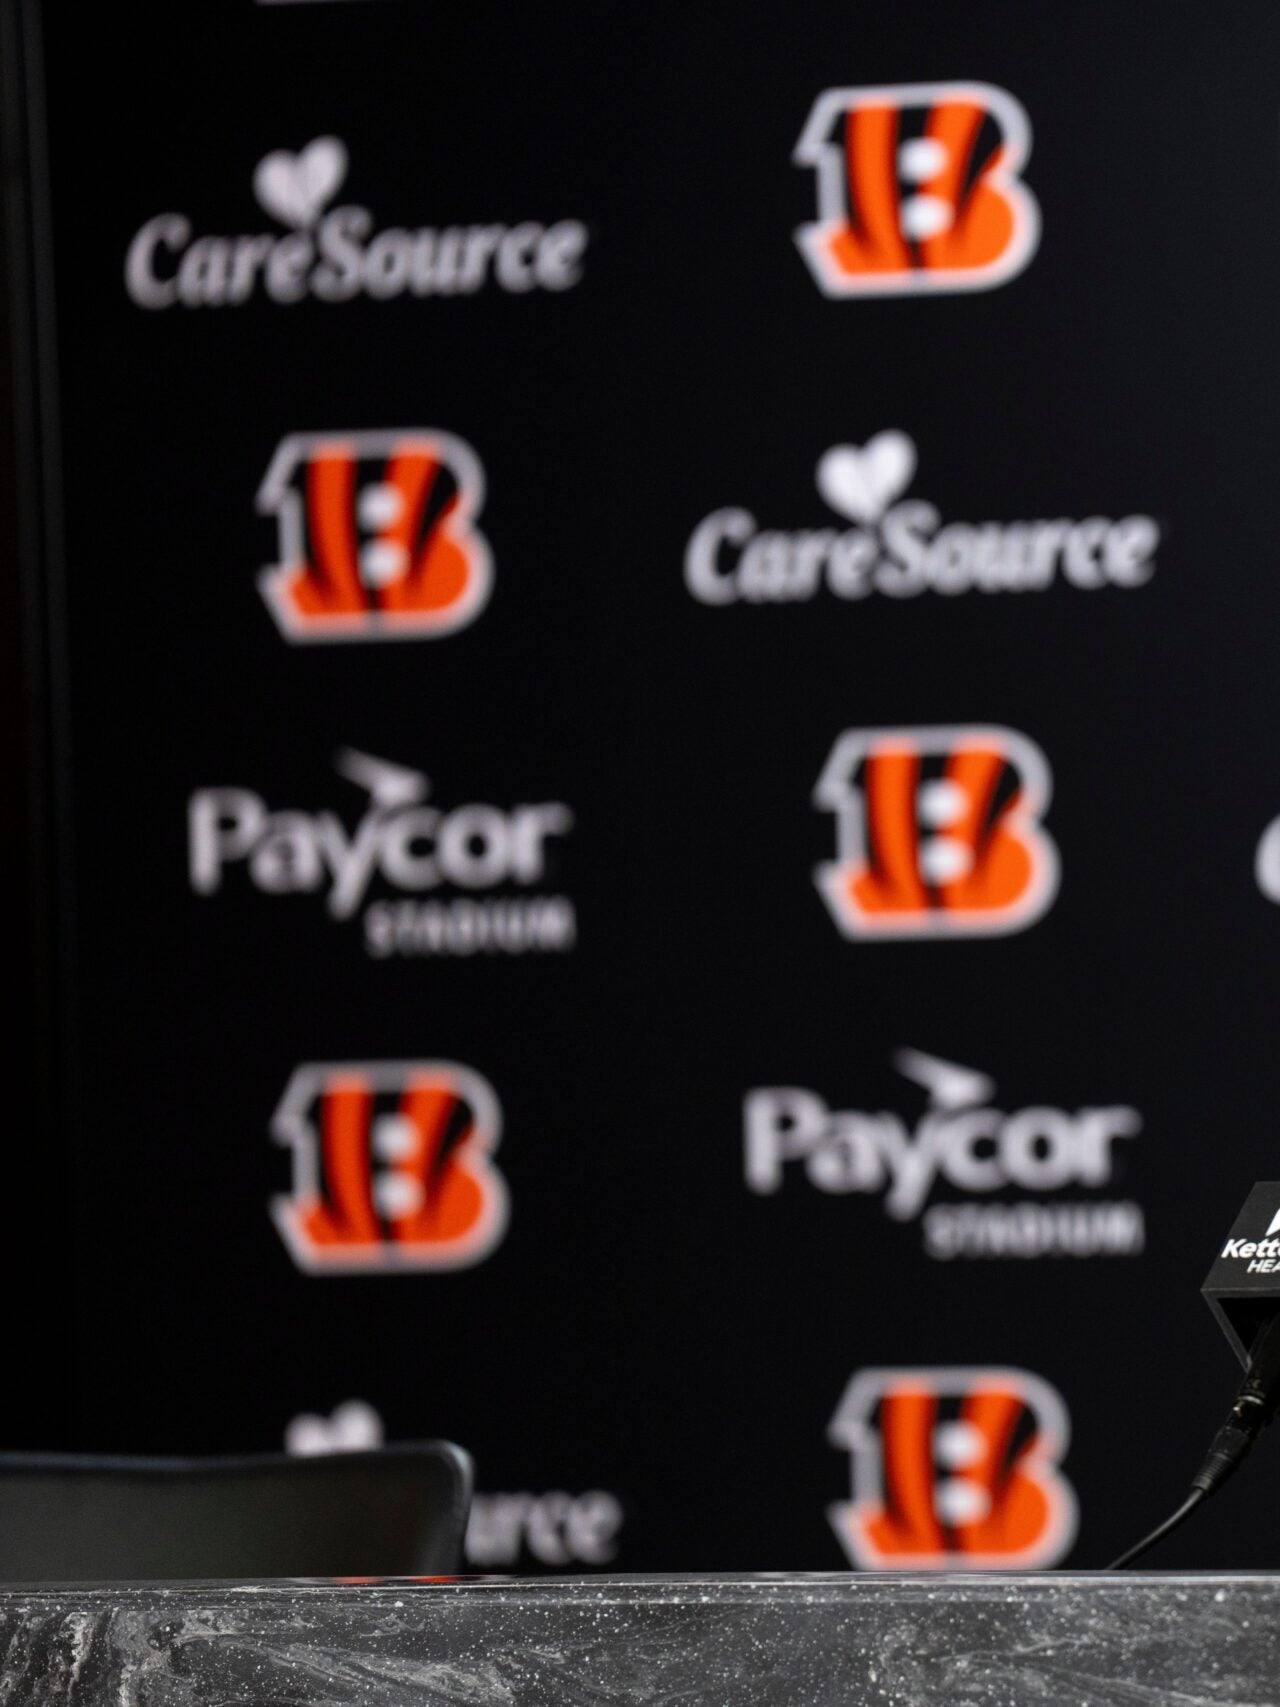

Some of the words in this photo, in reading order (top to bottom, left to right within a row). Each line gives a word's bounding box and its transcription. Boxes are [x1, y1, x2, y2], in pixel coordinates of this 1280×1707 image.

[127, 203, 585, 308] CareSource
[685, 500, 1159, 604] CareSource
[189, 788, 573, 919] Paycor
[366, 898, 574, 957] STADIUM
[744, 1087, 1142, 1221] Paycor
[923, 1202, 1144, 1260] STADIUM
